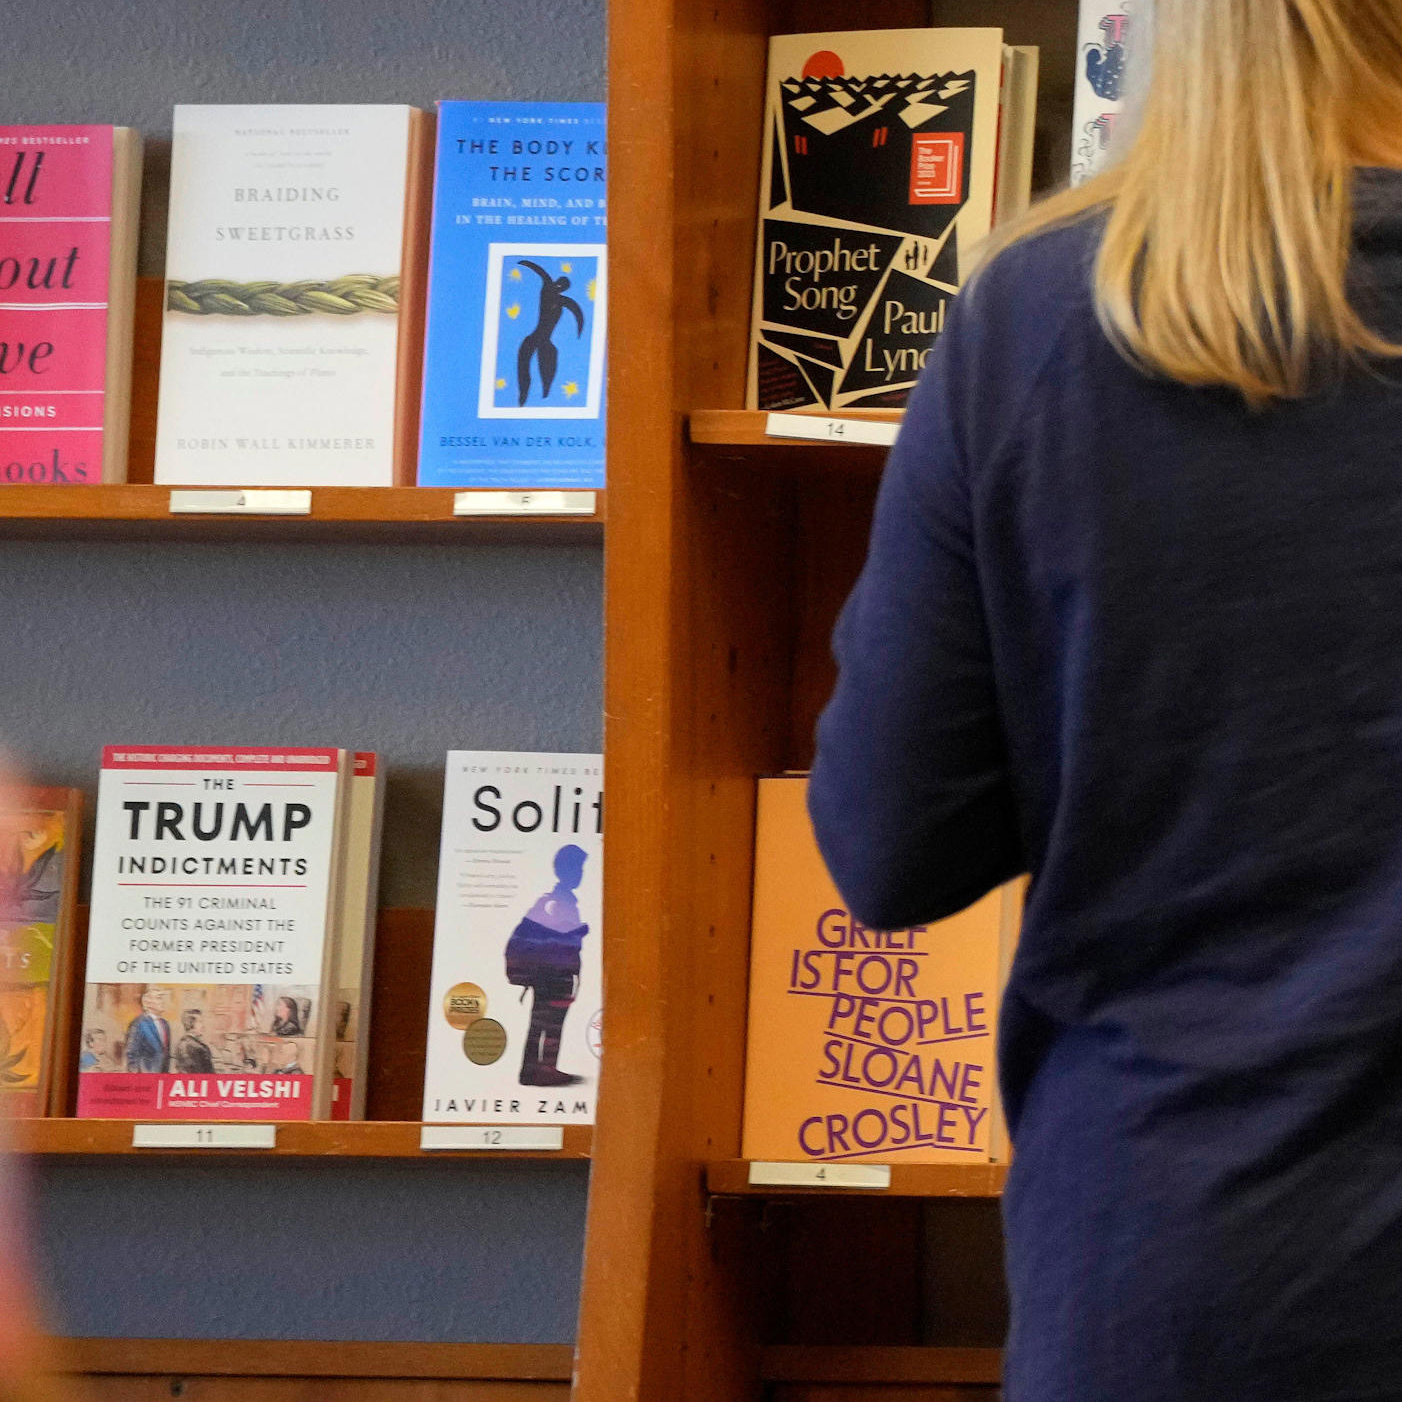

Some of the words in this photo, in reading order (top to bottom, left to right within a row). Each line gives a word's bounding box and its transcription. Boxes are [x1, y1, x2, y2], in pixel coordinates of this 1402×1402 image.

[234, 187, 341, 203] BRAIDING
[215, 225, 356, 242] SWEETGRASS
[769, 238, 881, 275] Prophet
[783, 277, 857, 319] Song
[123, 801, 313, 842] TRUMP
[118, 856, 308, 876] INDICTMENTS
[122, 918, 190, 932] COUNTS
[194, 919, 262, 932] AGAINST
[267, 920, 295, 932] THE
[129, 939, 195, 953] FORMER
[200, 940, 285, 953] PRESIDENT
[828, 992, 987, 1047] PEOPLE
[799, 1104, 989, 1157] CROSLEY
